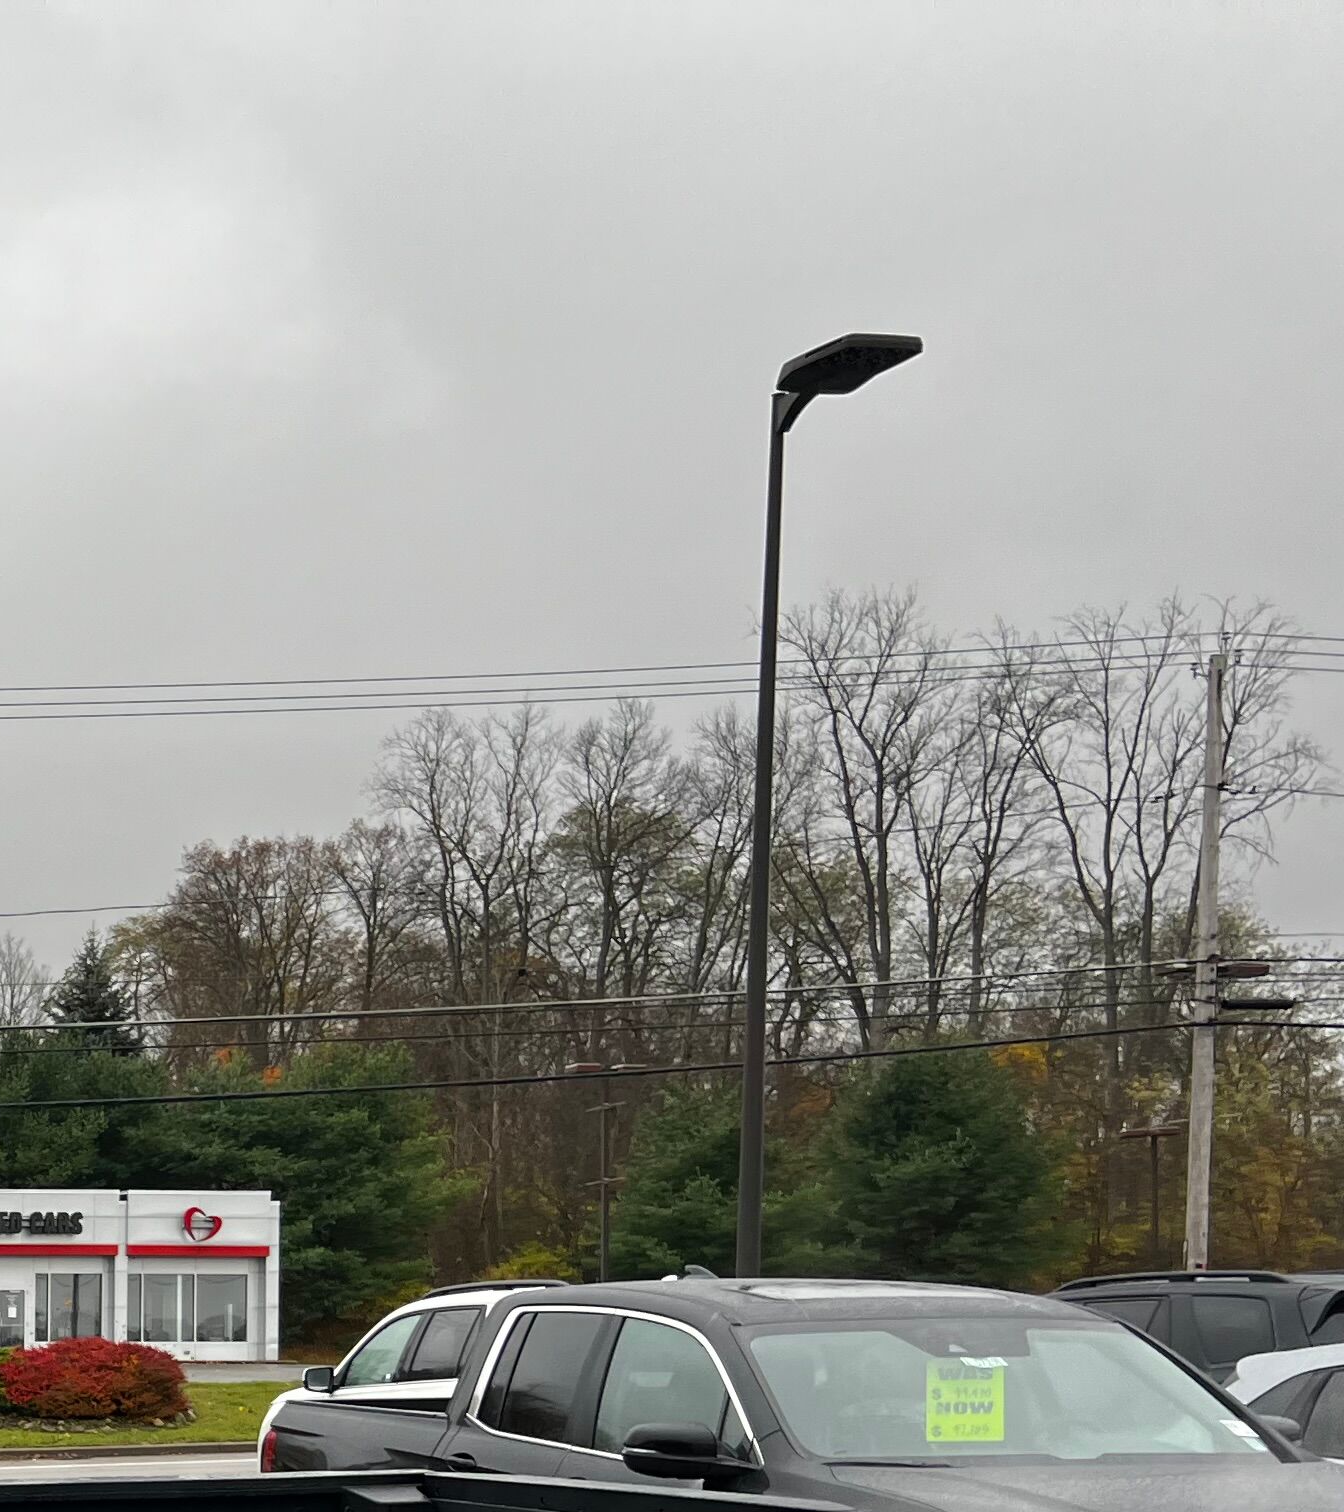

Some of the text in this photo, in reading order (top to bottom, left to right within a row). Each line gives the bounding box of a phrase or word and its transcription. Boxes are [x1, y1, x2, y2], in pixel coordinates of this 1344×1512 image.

[30, 1211, 83, 1234] CARS
[938, 1367, 993, 1381] WAS
[935, 1401, 994, 1415] NOW
